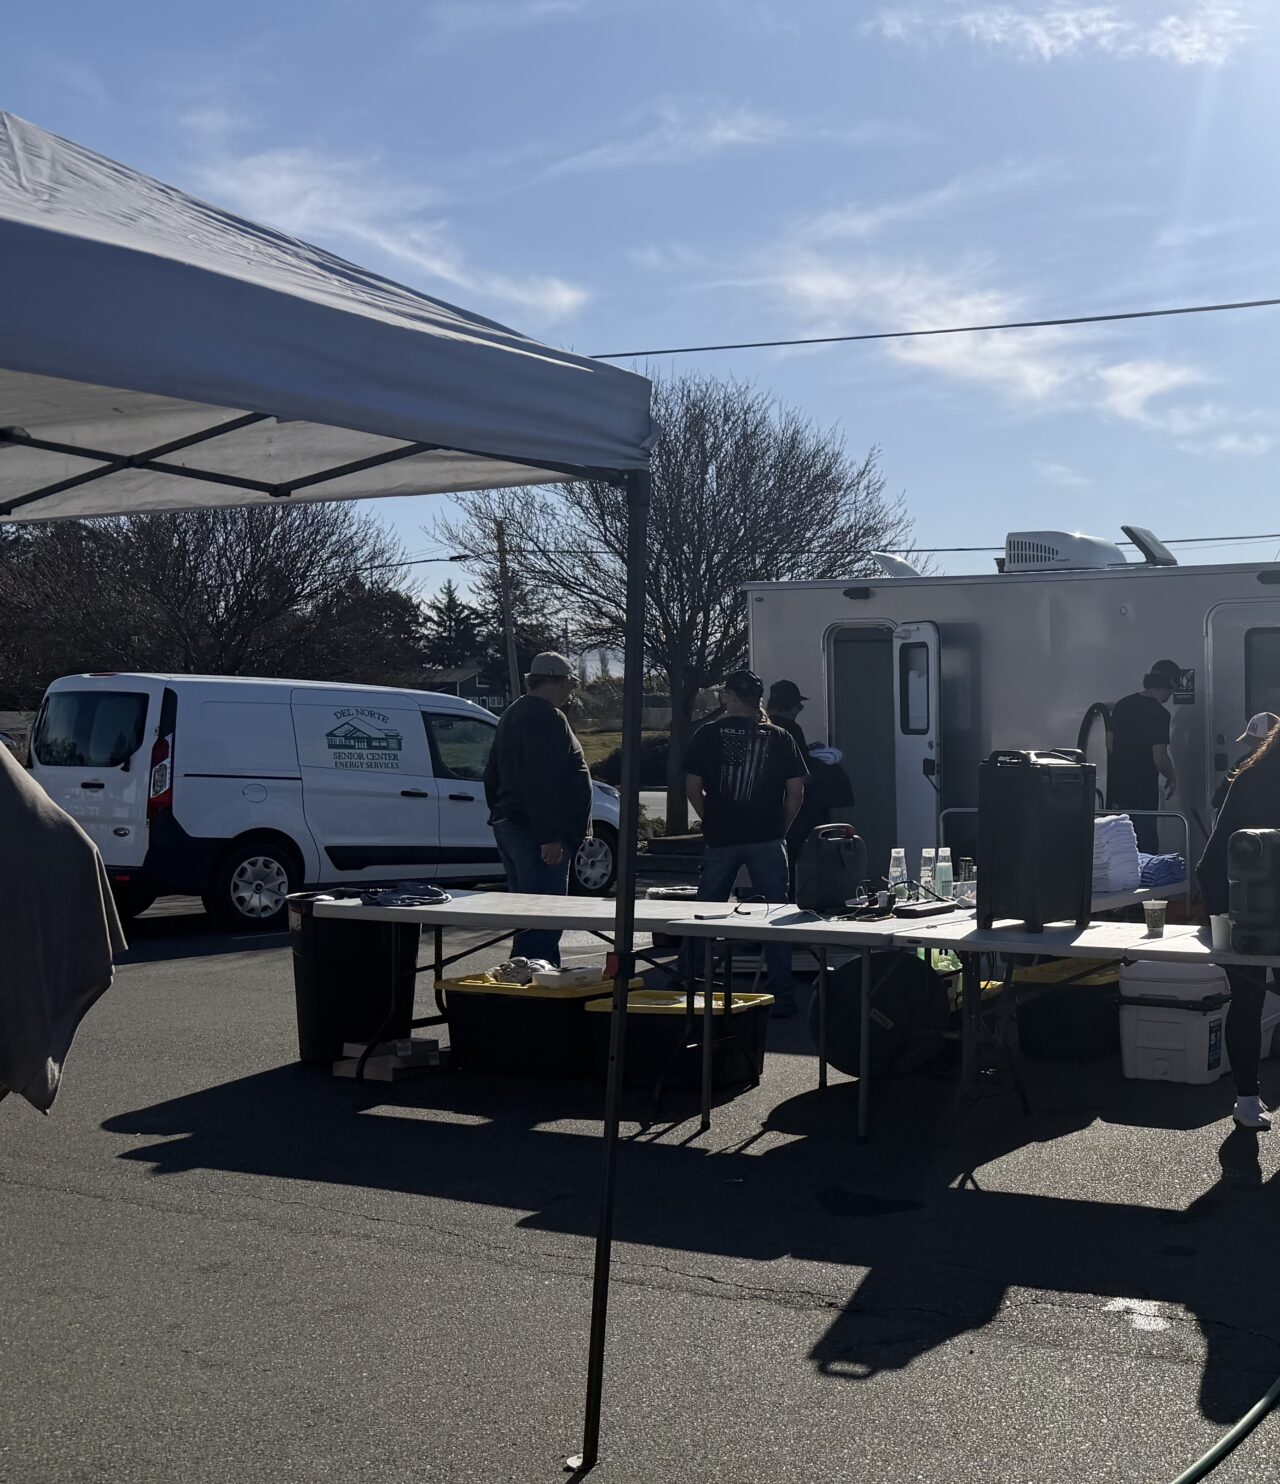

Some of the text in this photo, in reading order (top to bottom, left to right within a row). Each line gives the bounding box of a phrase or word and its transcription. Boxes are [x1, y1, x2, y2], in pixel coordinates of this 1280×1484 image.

[334, 709, 390, 724] DEL NORTE
[333, 752, 400, 761] SENIOR CENTER
[335, 761, 400, 769] ENERGY SERVICES
